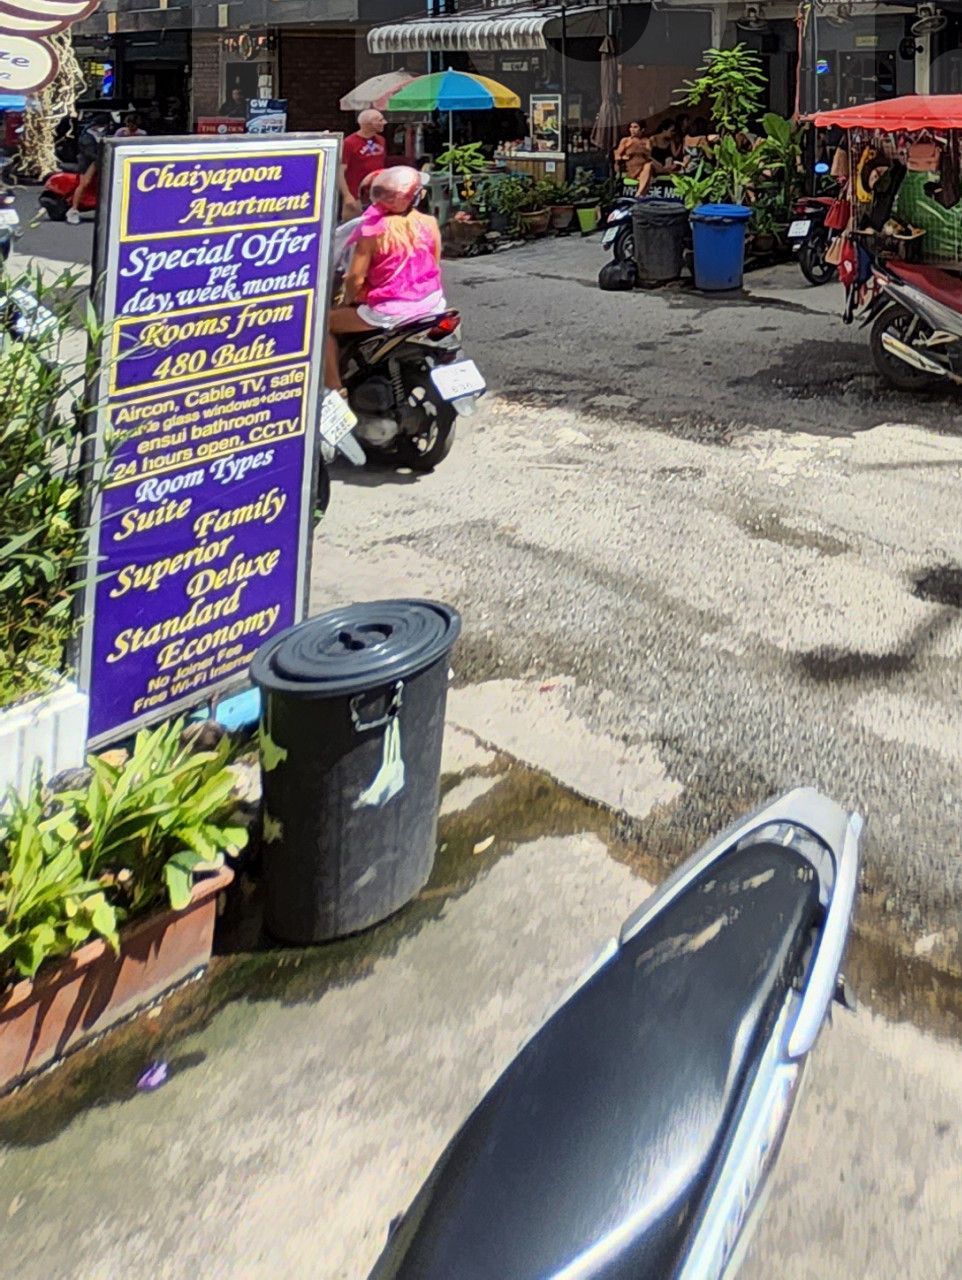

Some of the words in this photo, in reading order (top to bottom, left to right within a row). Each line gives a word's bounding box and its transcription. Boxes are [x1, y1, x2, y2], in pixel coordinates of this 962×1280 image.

[136, 163, 282, 194] Chaiyapoon
[178, 191, 310, 226] Apartment
[120, 233, 243, 282] Special
[241, 227, 317, 266] Offer
[207, 262, 241, 286] per
[139, 315, 230, 348] Rooms
[227, 304, 294, 340] from
[152, 349, 207, 380] 480
[211, 334, 277, 369] Baht
[115, 399, 180, 425] Aircon,
[184, 385, 236, 408] Cable
[239, 376, 267, 395] TV,
[270, 369, 305, 389] safe
[163, 411, 200, 432] glass
[114, 459, 138, 480] 24
[142, 447, 193, 470] hours
[197, 434, 244, 459] open,
[249, 417, 300, 442] CCTV
[137, 428, 187, 454] ensui
[191, 410, 271, 440] bathroom
[135, 468, 205, 503] Room
[209, 449, 275, 484] Types
[113, 497, 193, 541] Suite
[193, 487, 287, 539] Family
[109, 535, 235, 598] Superior
[186, 549, 281, 599] Deluxe
[106, 581, 248, 663] Standard
[156, 604, 281, 671] Economy
[147, 674, 171, 693] No
[216, 643, 243, 663] Fee
[132, 692, 168, 714] Free
